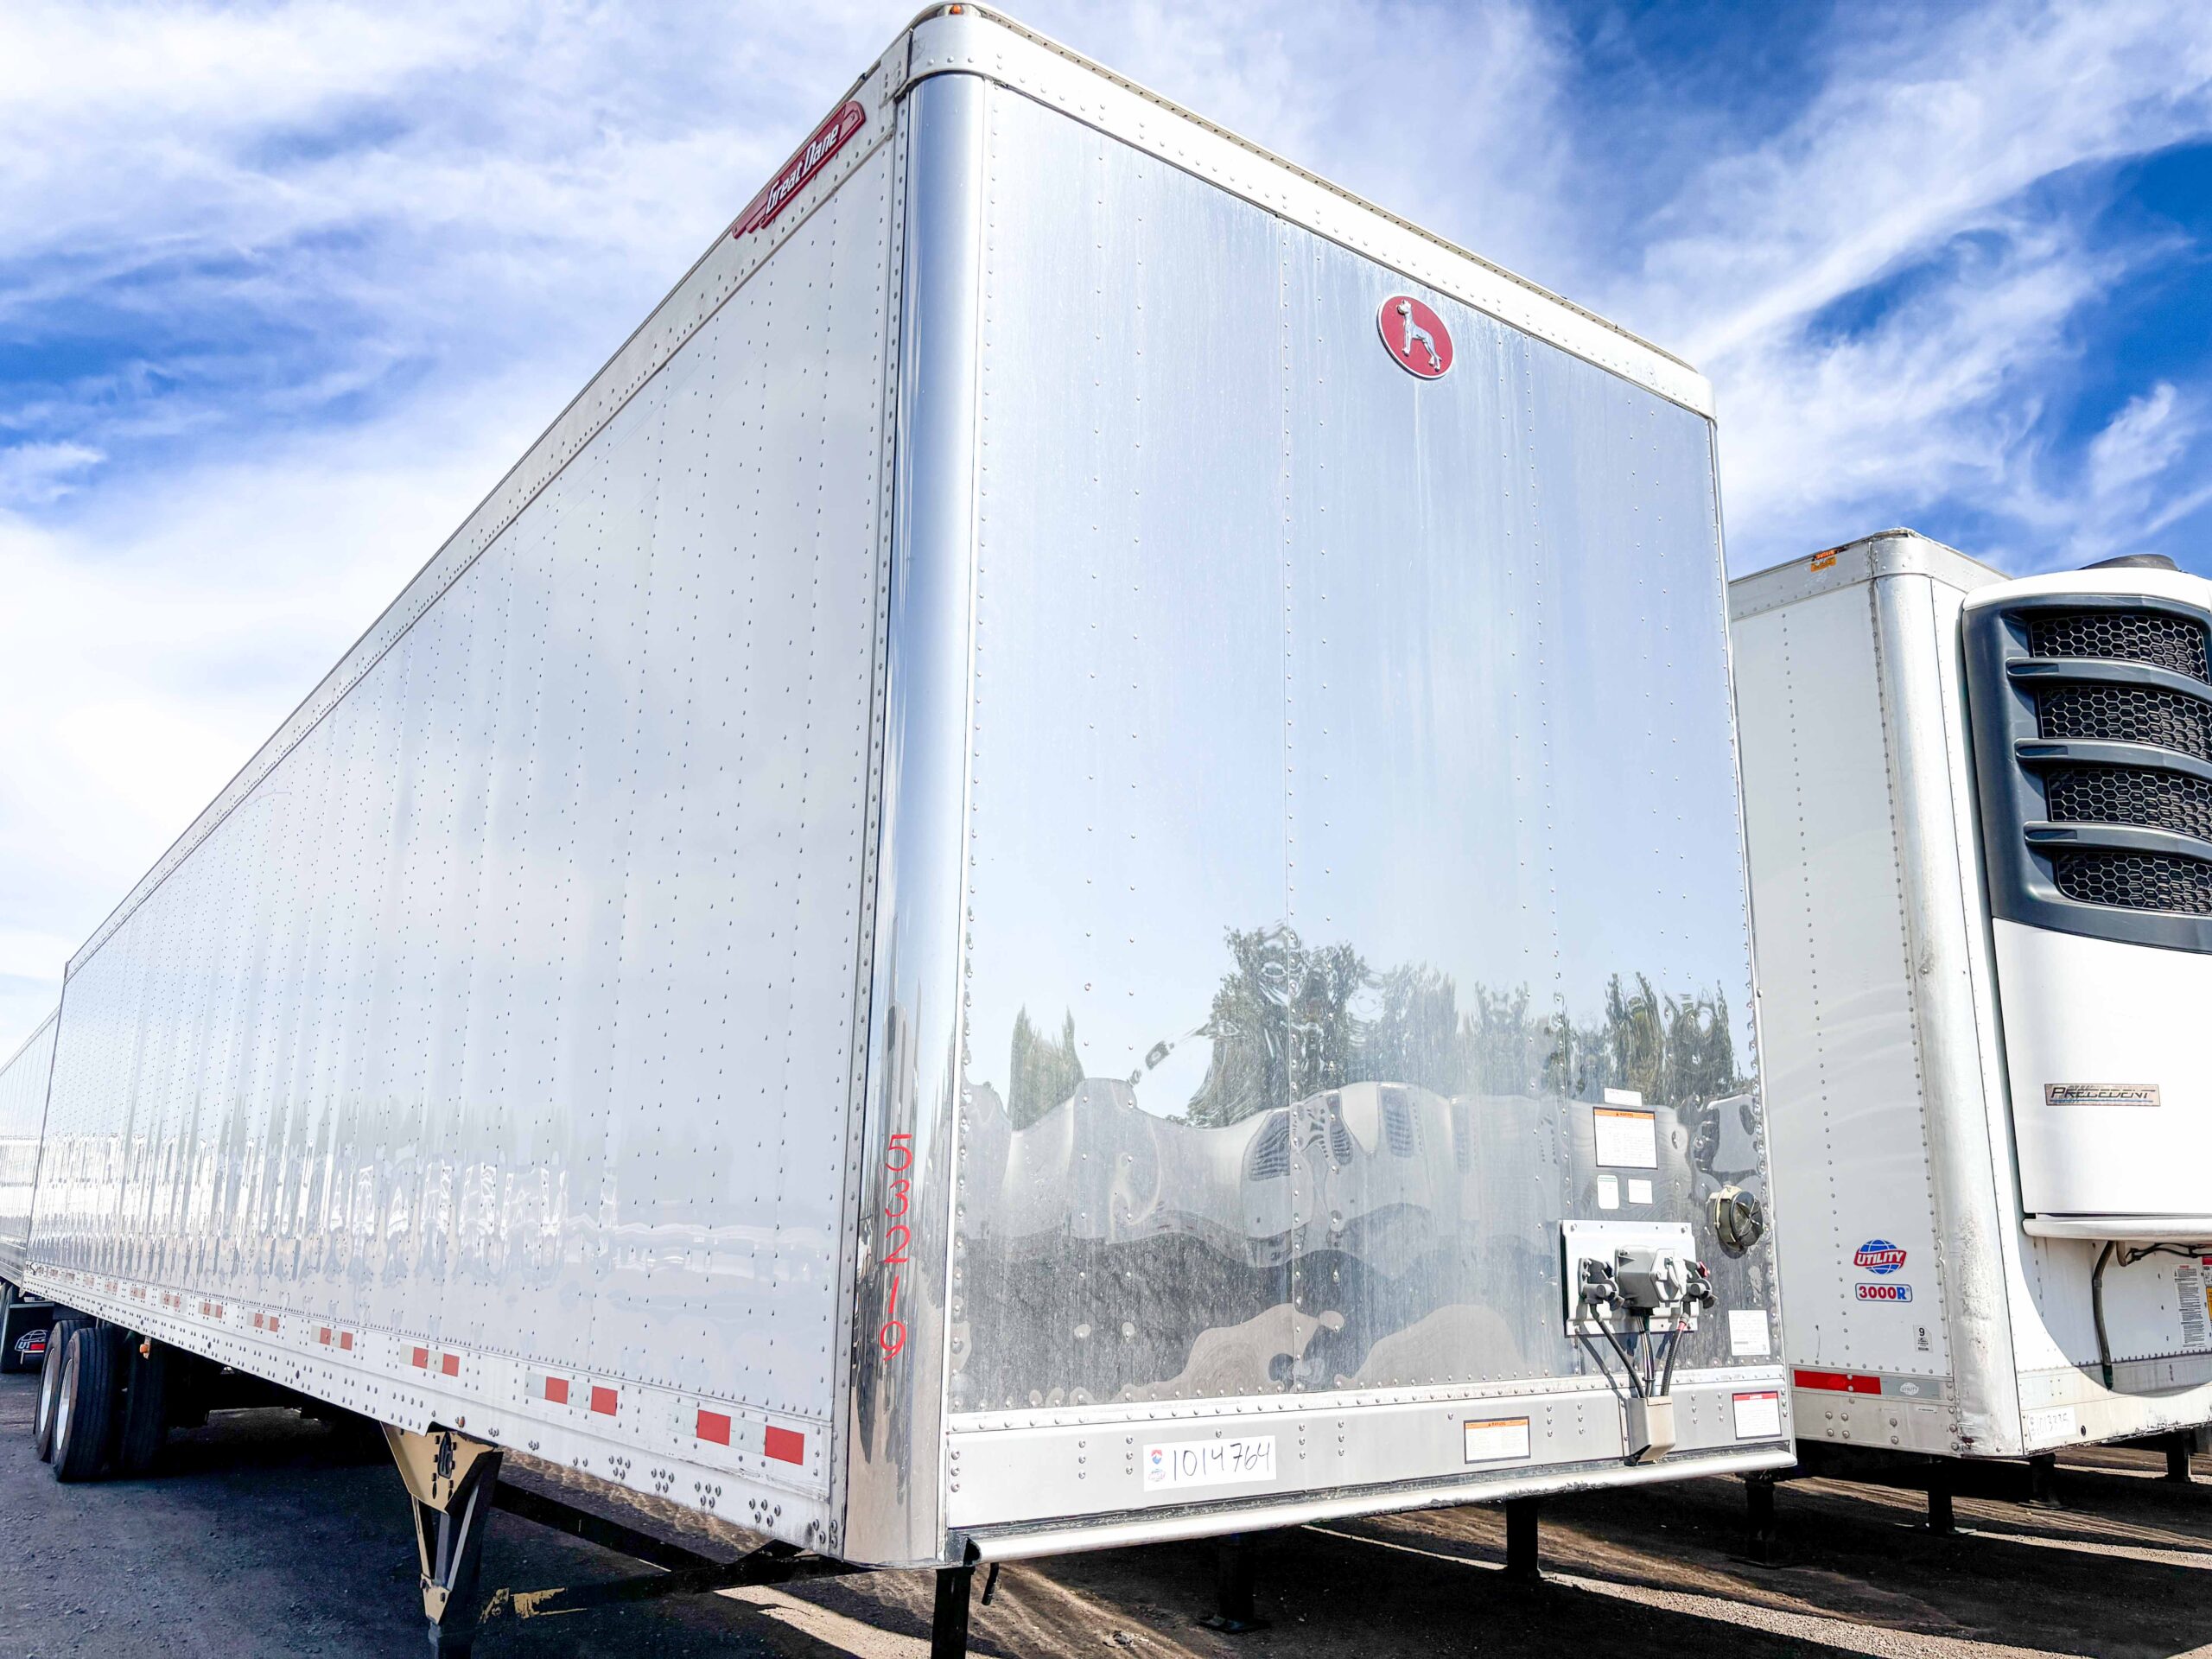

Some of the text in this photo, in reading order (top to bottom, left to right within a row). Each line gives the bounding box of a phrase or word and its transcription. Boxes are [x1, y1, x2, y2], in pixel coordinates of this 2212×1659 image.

[766, 124, 840, 215] Great Dane
[880, 1133, 913, 1362] 53219
[1857, 1251, 1904, 1265] UTILITY
[1859, 1285, 1907, 1300] 3000R
[1918, 1327, 1925, 1337] 9
[1173, 1442, 1270, 1481] 1014764
